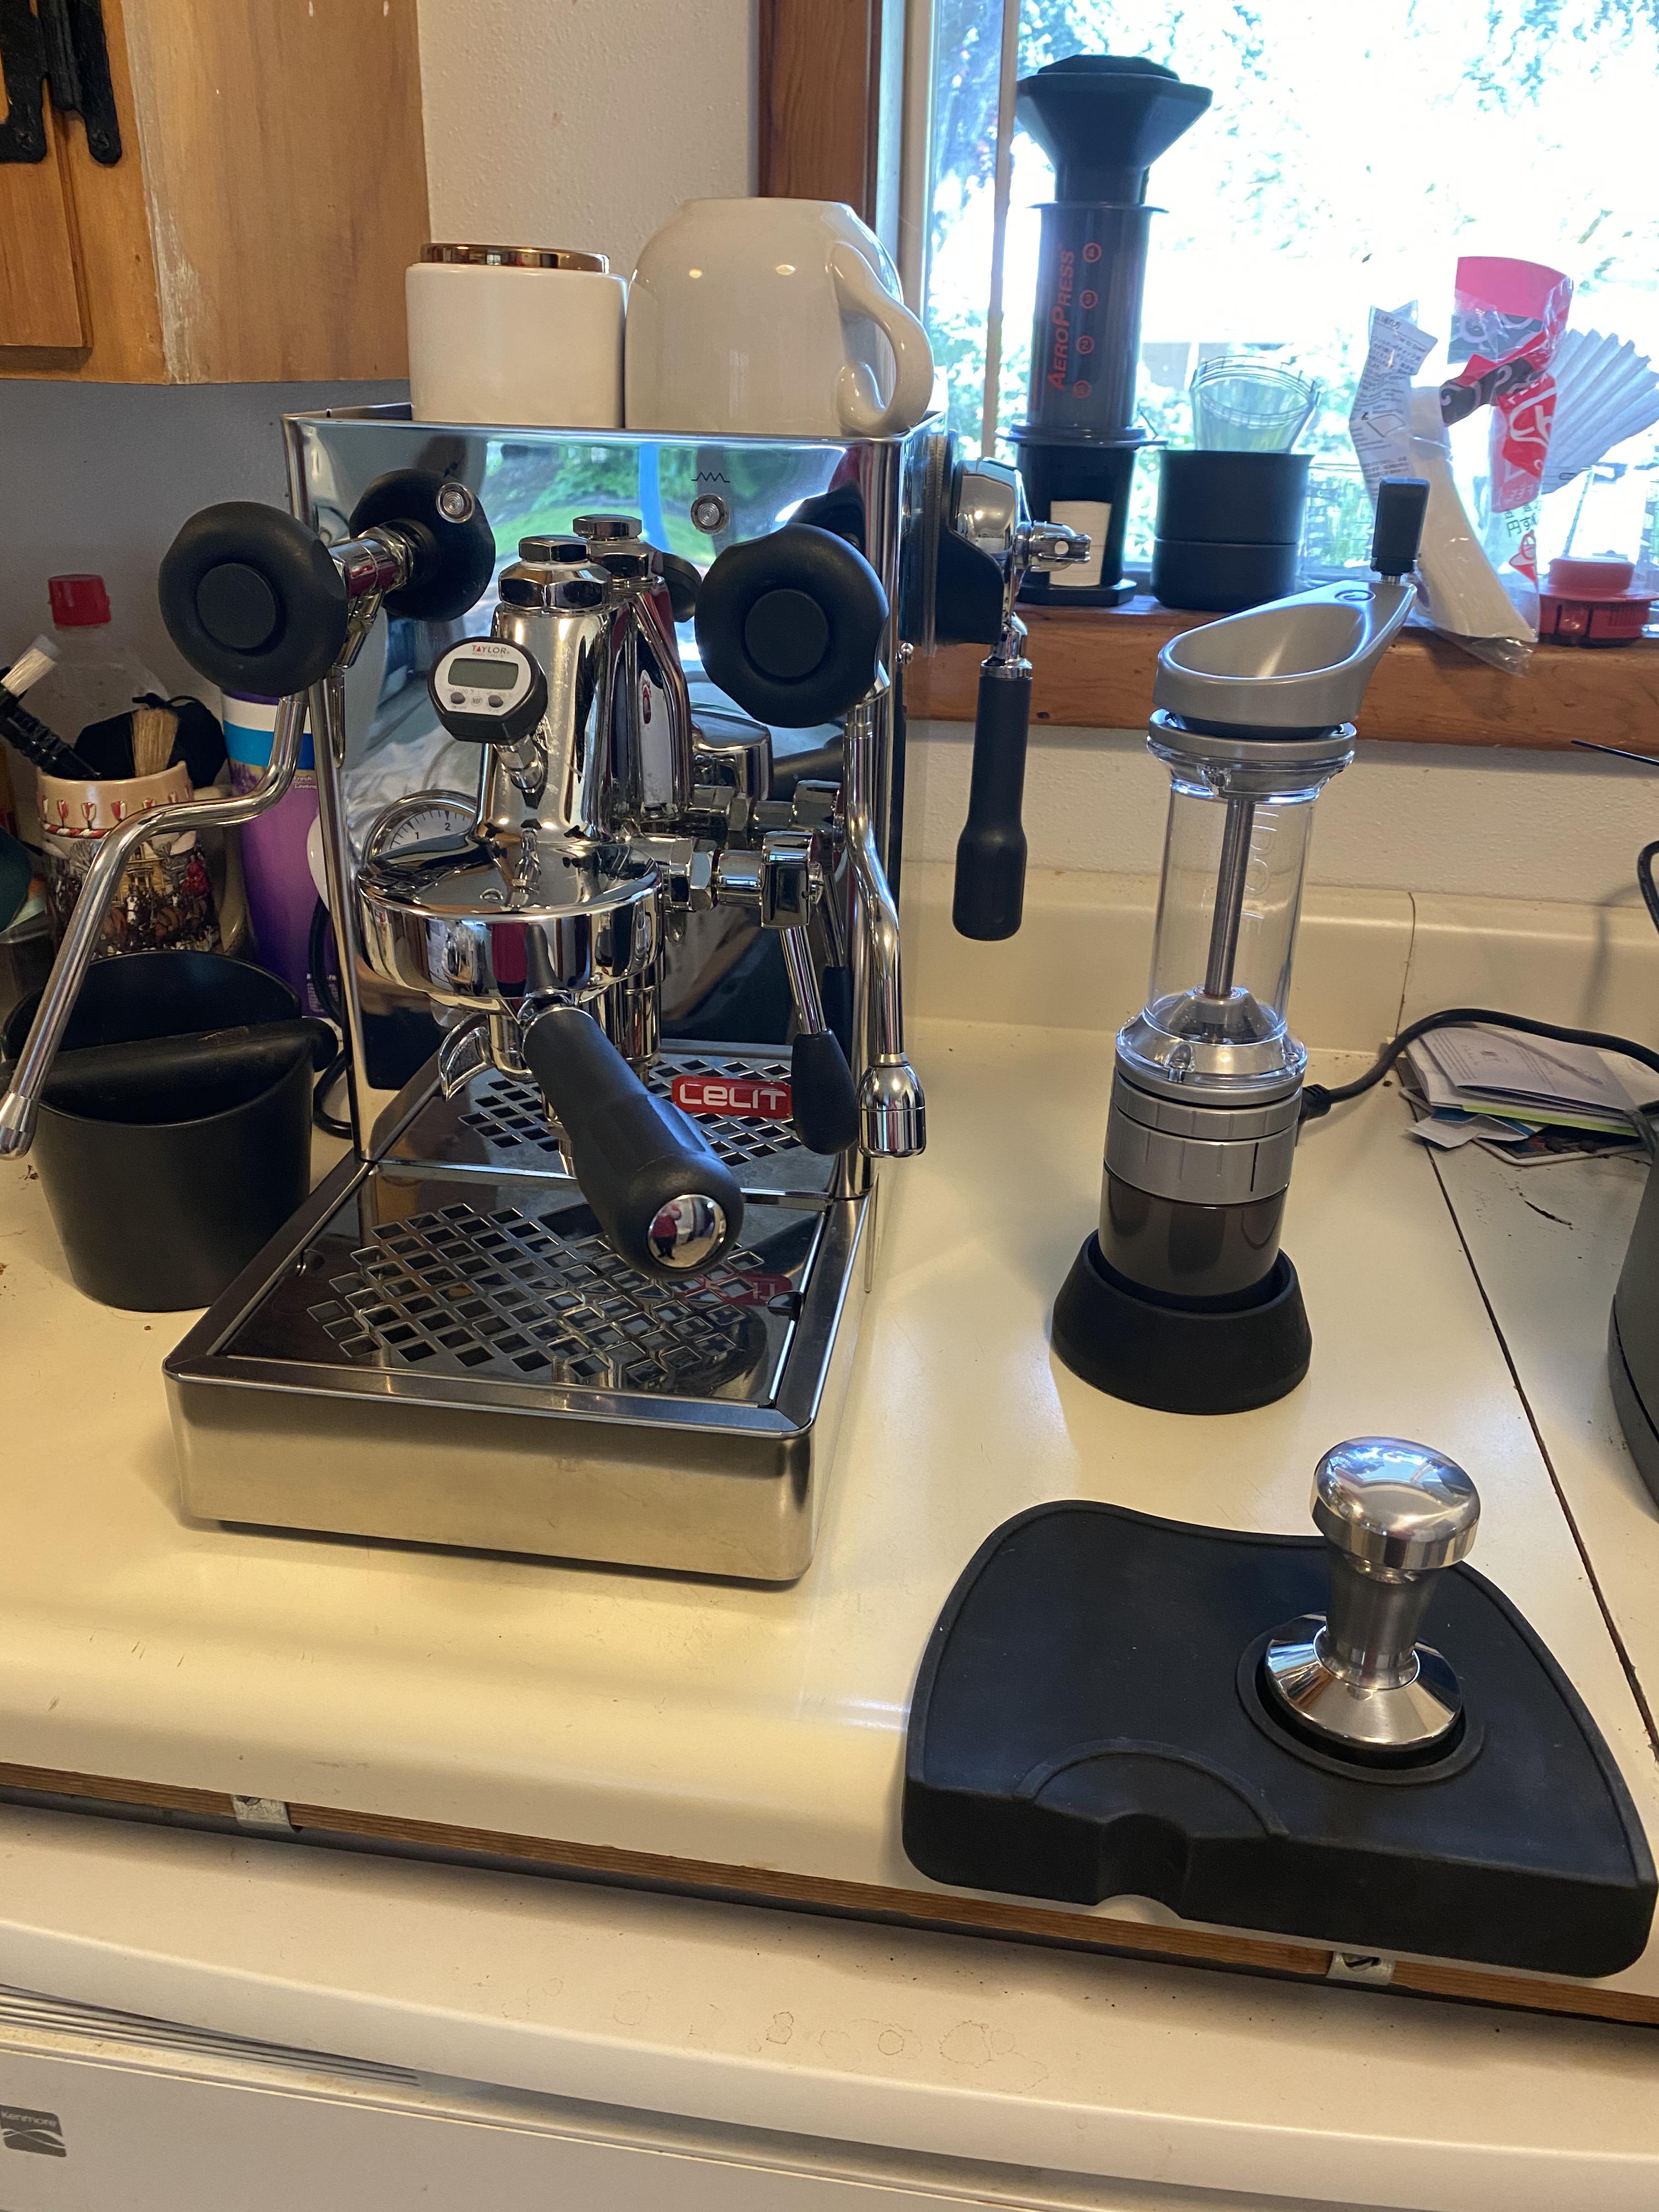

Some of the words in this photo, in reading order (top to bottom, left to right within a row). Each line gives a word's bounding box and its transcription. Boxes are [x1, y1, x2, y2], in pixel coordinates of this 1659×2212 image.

[472, 645, 507, 654] TAYLOR
[445, 822, 450, 831] 2
[1, 2111, 57, 2126] Kenmore
